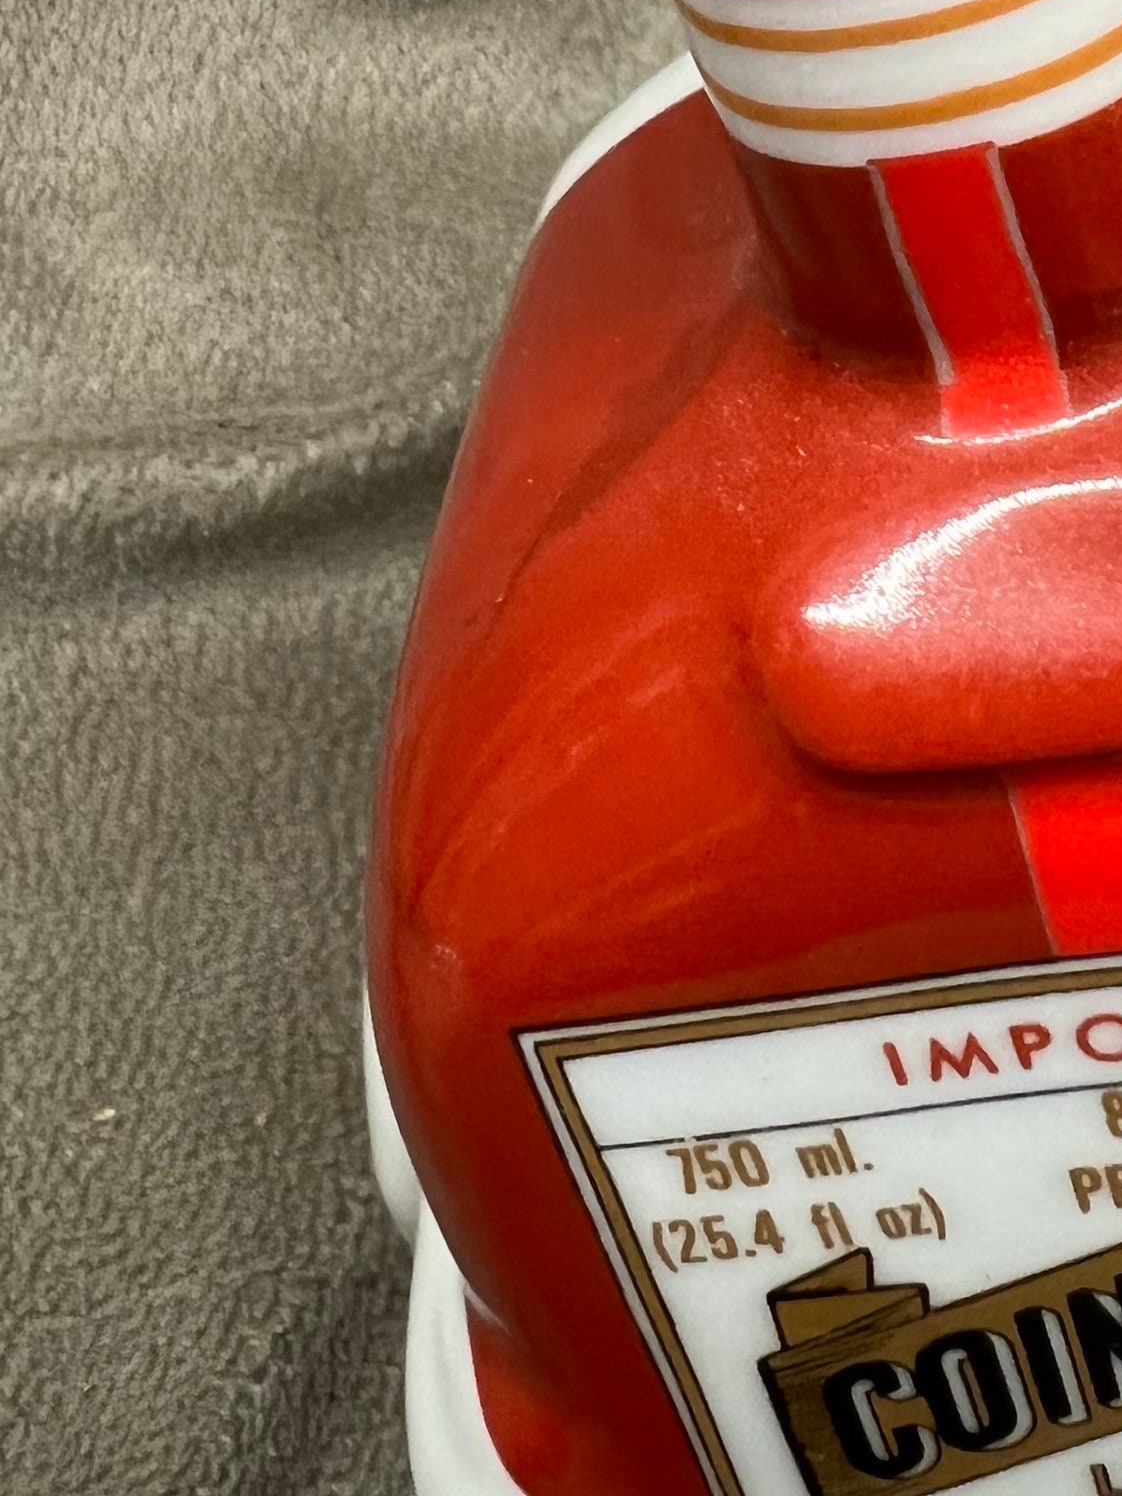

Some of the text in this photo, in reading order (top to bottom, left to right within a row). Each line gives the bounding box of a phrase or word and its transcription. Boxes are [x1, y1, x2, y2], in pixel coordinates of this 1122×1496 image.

[666, 1127, 874, 1195] 750 ml.
[652, 1187, 946, 1273] (25.4 fl oz)
